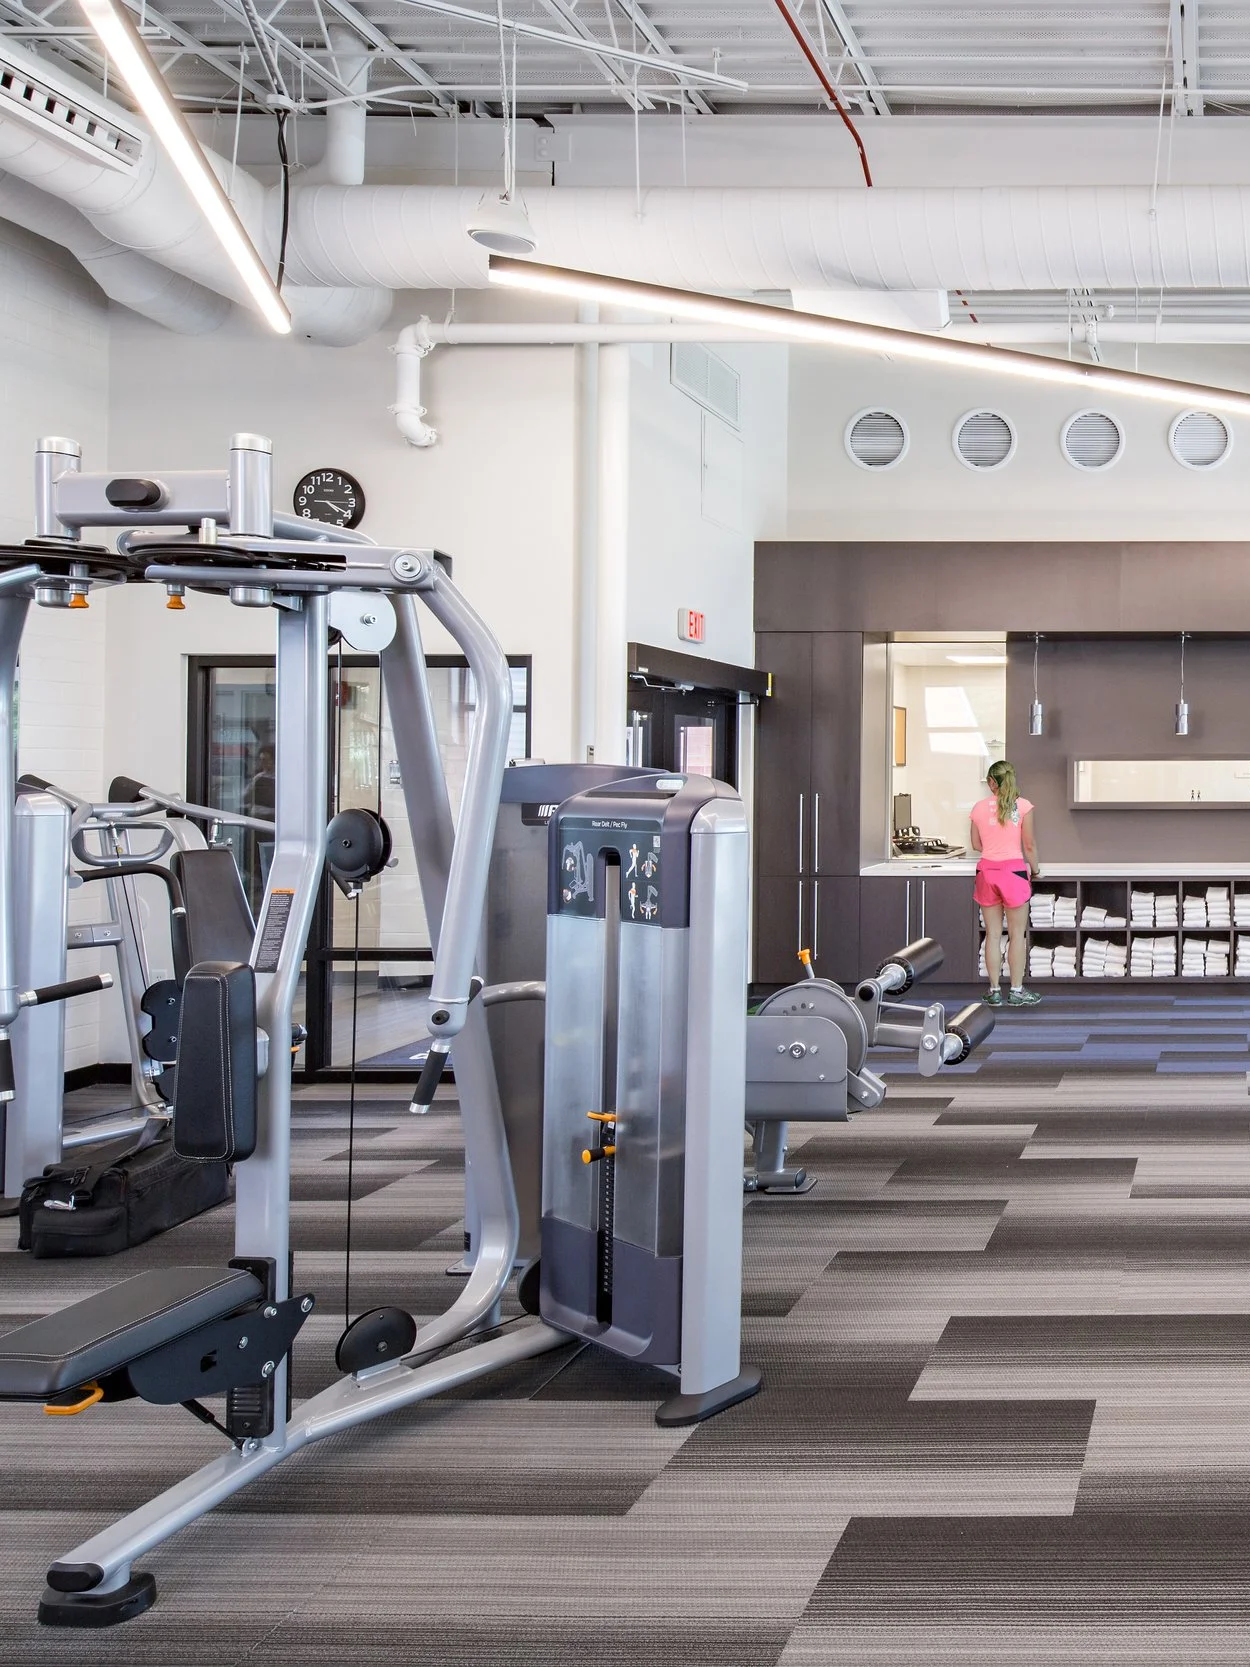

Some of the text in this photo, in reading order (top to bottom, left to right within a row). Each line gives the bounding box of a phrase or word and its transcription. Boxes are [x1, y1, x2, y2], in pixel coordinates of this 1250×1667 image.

[311, 476, 320, 485] 11
[321, 473, 334, 482] 12
[337, 477, 342, 485] 1
[302, 485, 315, 494] 10
[344, 485, 352, 494] 2
[299, 496, 307, 505] 9
[348, 498, 356, 507] 3
[302, 508, 311, 518] 8
[343, 509, 352, 519] 4
[336, 519, 344, 527] 5
[688, 610, 705, 640] EXIT
[601, 820, 610, 828] Delt
[620, 821, 628, 829] Fly
